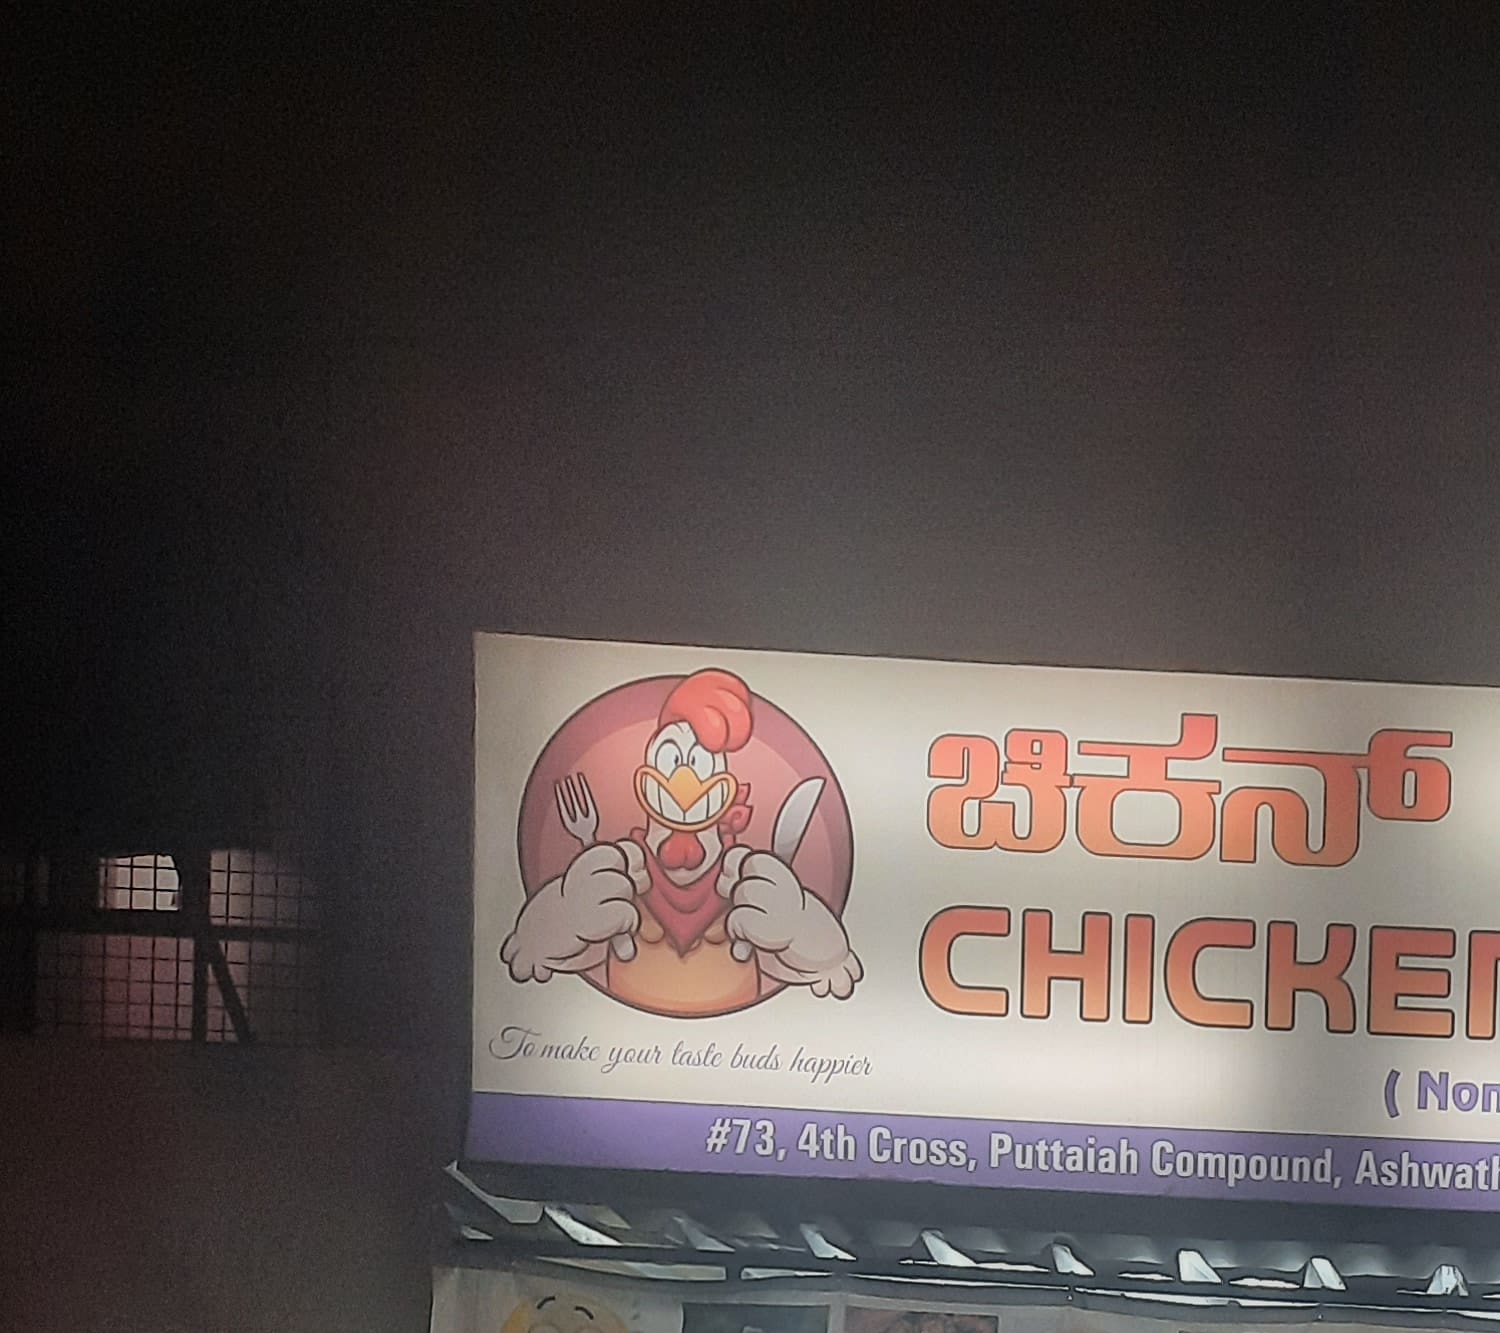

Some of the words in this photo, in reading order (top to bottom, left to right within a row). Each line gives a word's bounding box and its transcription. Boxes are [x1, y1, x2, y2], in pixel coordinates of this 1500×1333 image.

[927, 713, 1453, 868] ಚಿಕನ್
[488, 1025, 541, 1061] To
[541, 1035, 600, 1062] make
[600, 1043, 662, 1074] your
[671, 1040, 723, 1068] taste
[730, 1043, 782, 1072] buds
[788, 1046, 873, 1084] happier
[705, 1117, 788, 1162] #73,
[797, 1121, 857, 1162] 4th
[868, 1126, 979, 1172] Cross,
[989, 1132, 1139, 1176] Puttaiah
[1150, 1142, 1343, 1189] Compound,
